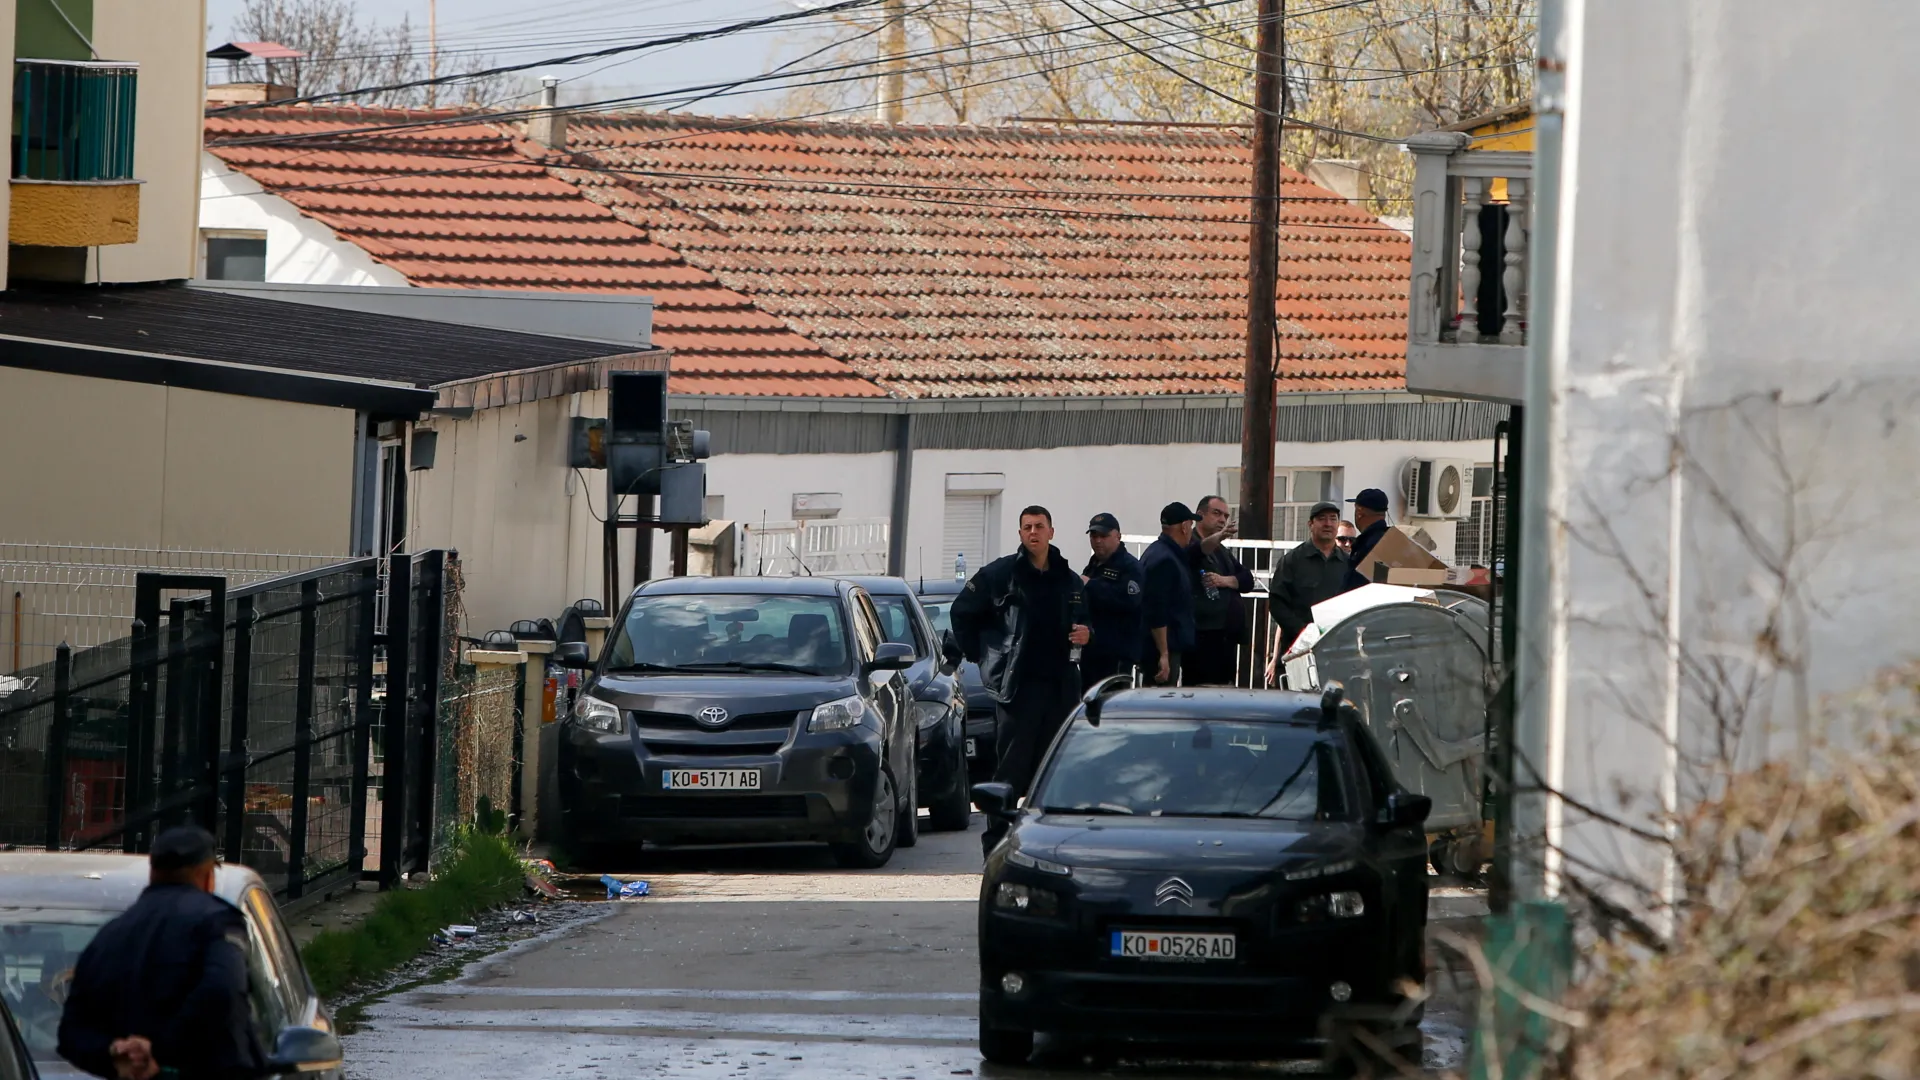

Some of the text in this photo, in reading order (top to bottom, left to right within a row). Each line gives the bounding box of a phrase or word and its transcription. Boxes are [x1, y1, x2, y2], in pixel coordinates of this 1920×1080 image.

[672, 771, 758, 787] KO 5171 AB
[1123, 936, 1234, 957] KO 0526 AD
